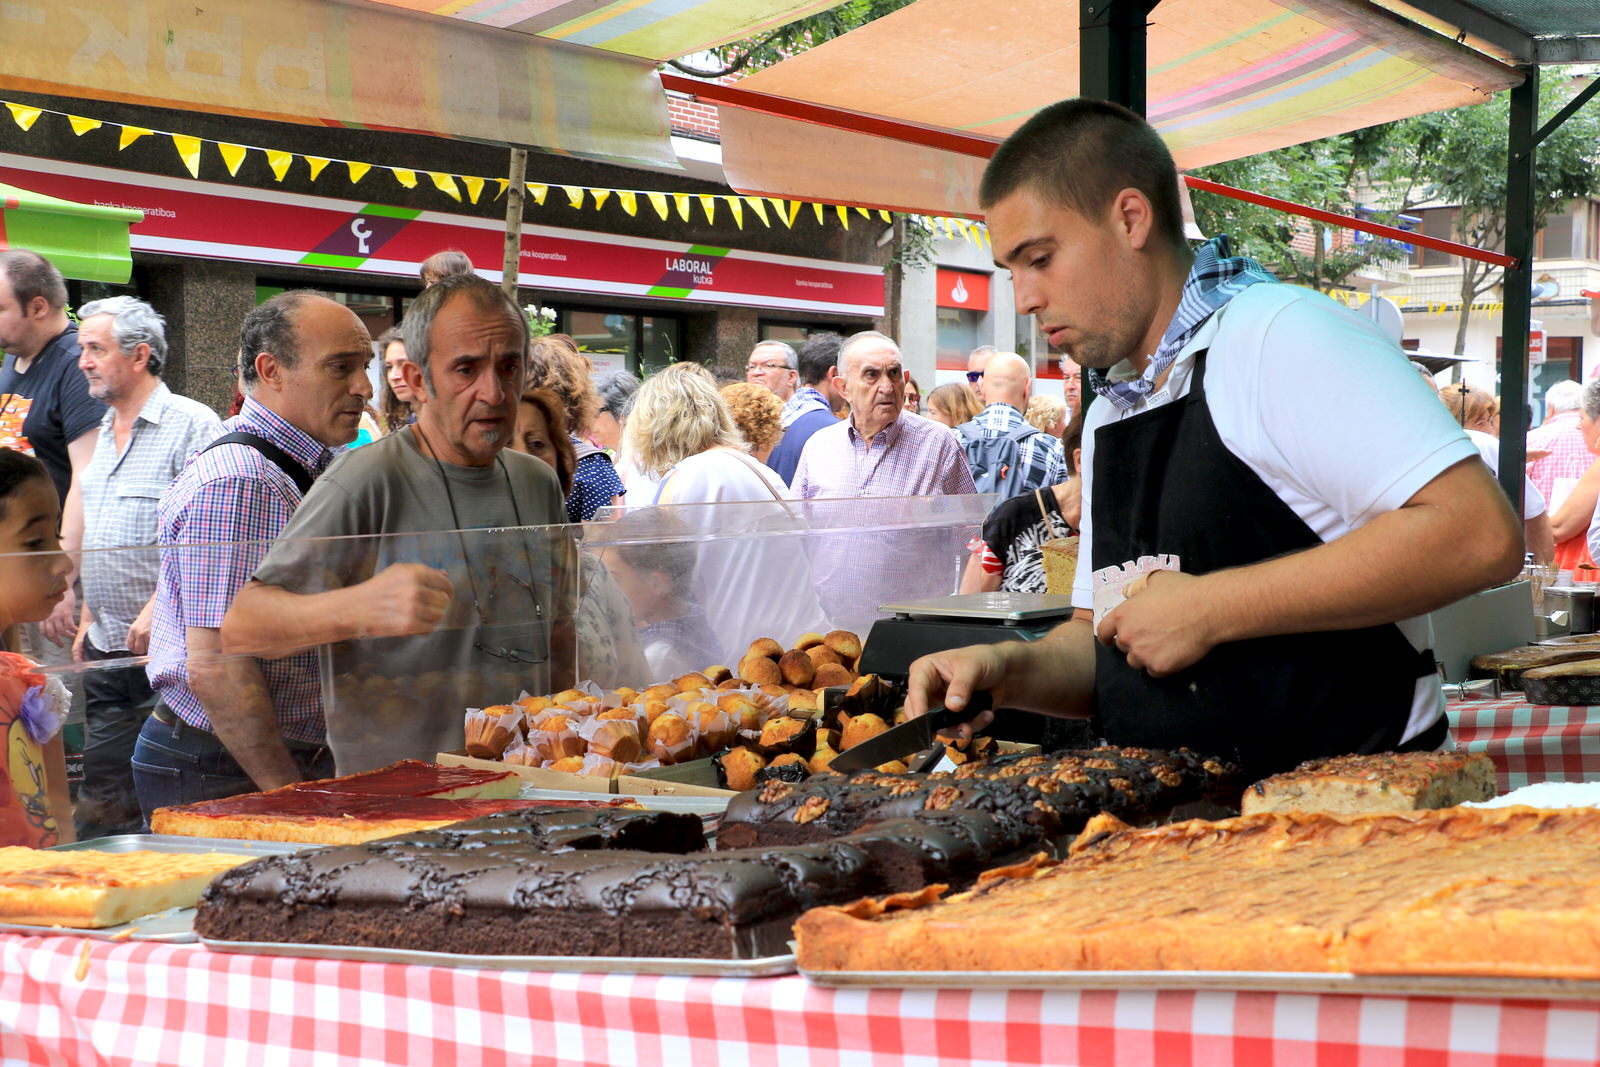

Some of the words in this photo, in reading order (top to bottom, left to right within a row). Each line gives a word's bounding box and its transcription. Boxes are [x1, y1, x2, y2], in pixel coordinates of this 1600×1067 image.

[532, 250, 567, 261] kooperatiboa
[665, 257, 713, 275] LABORAL
[693, 274, 713, 285] kutxa
